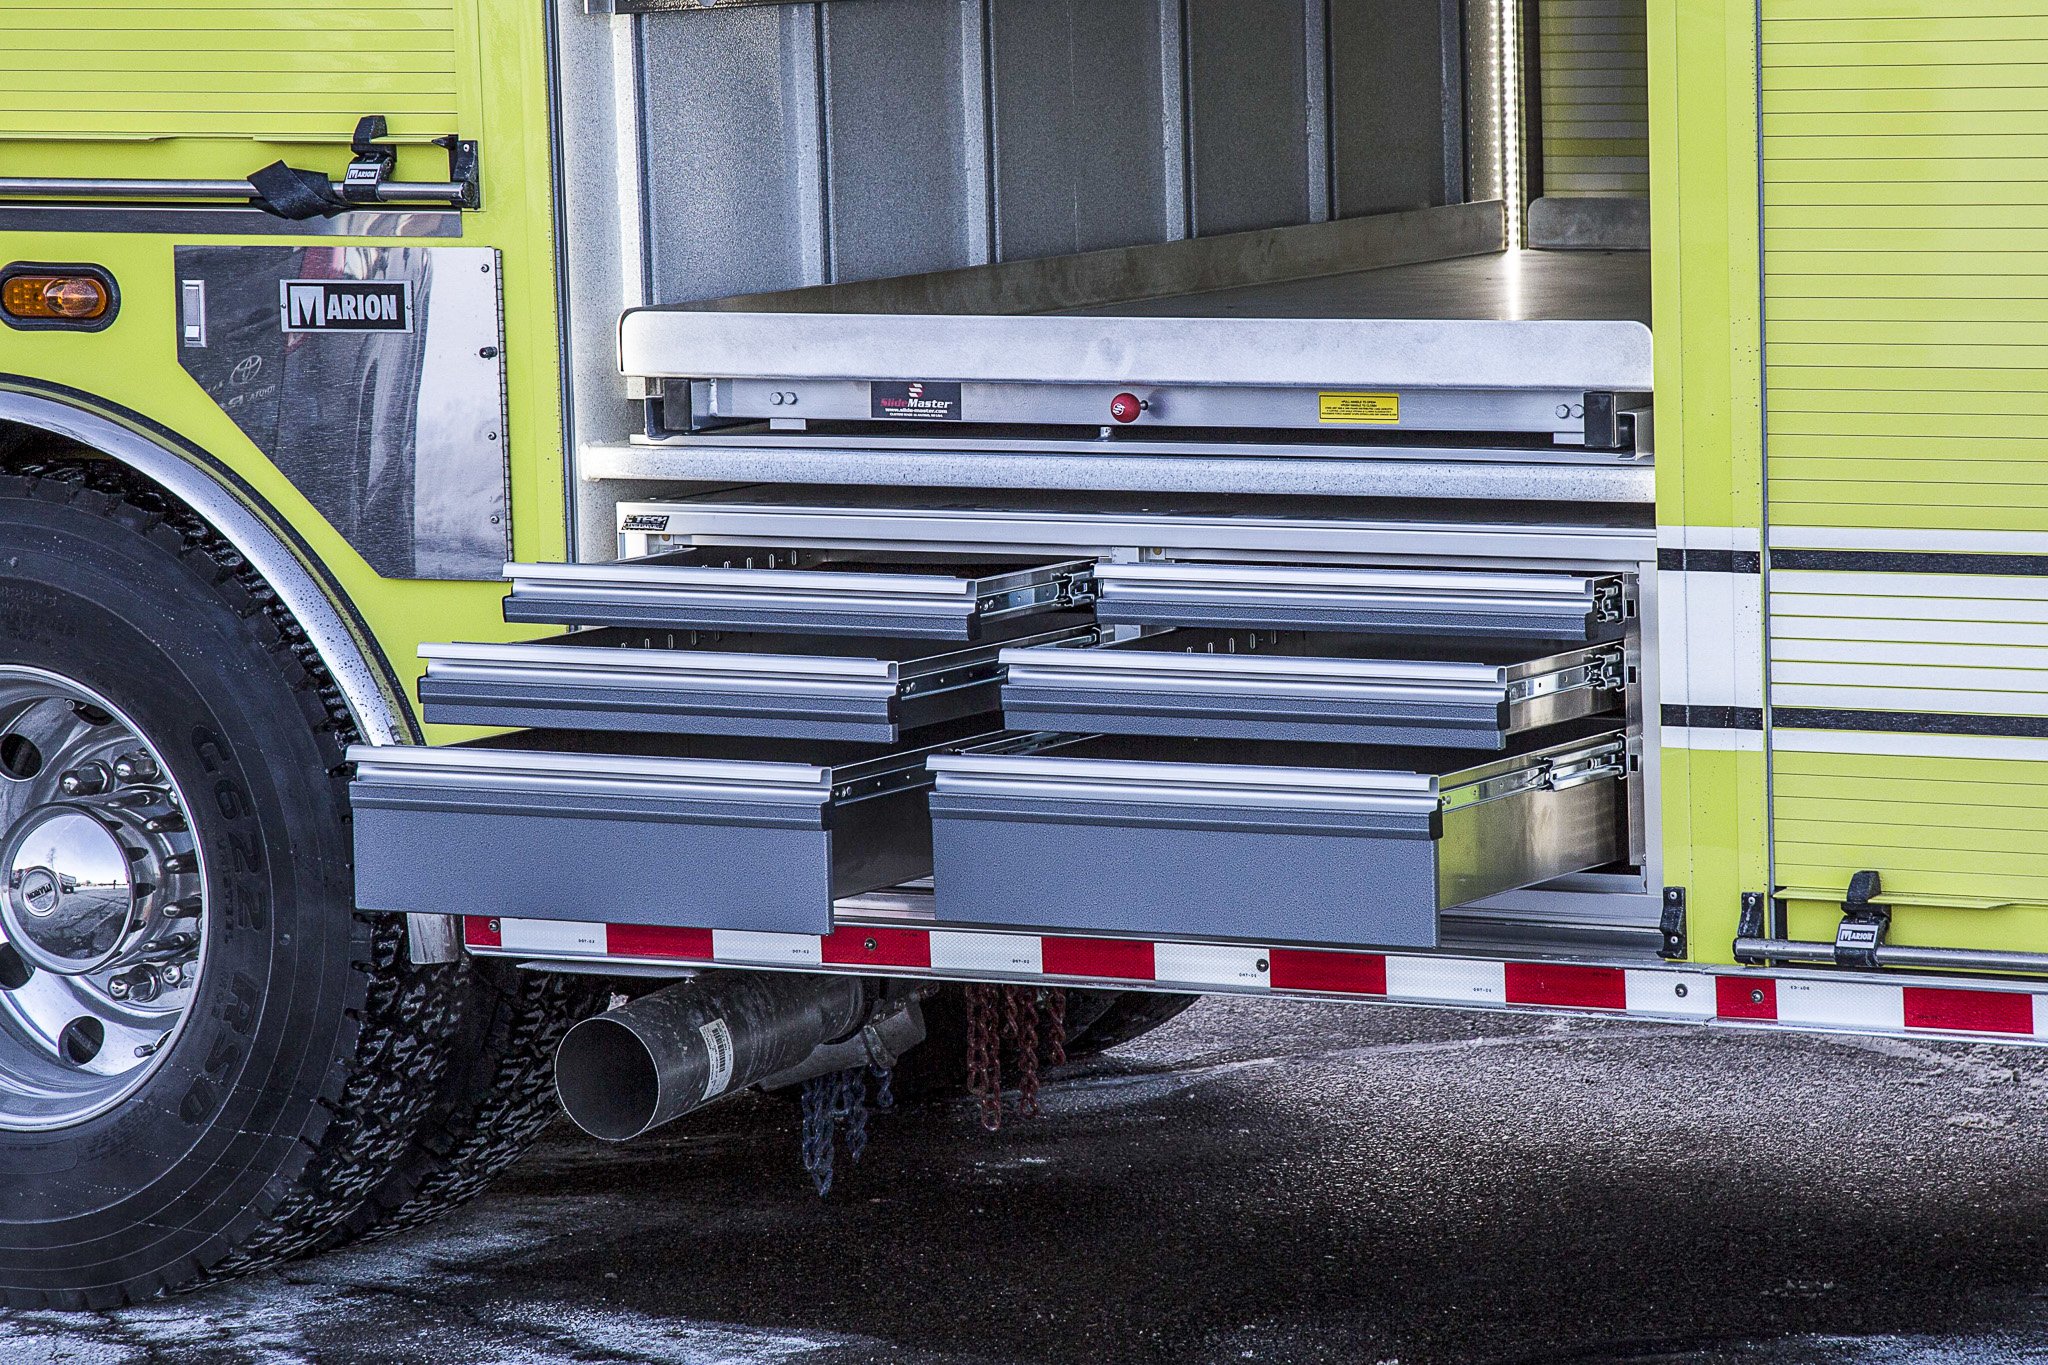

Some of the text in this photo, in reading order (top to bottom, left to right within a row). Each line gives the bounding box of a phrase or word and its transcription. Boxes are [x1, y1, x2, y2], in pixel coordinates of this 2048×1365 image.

[349, 169, 377, 178] MARION
[290, 286, 397, 326] MARION
[880, 398, 951, 408] SlideMaster
[190, 725, 267, 932] G622
[1841, 931, 1873, 941] MARION
